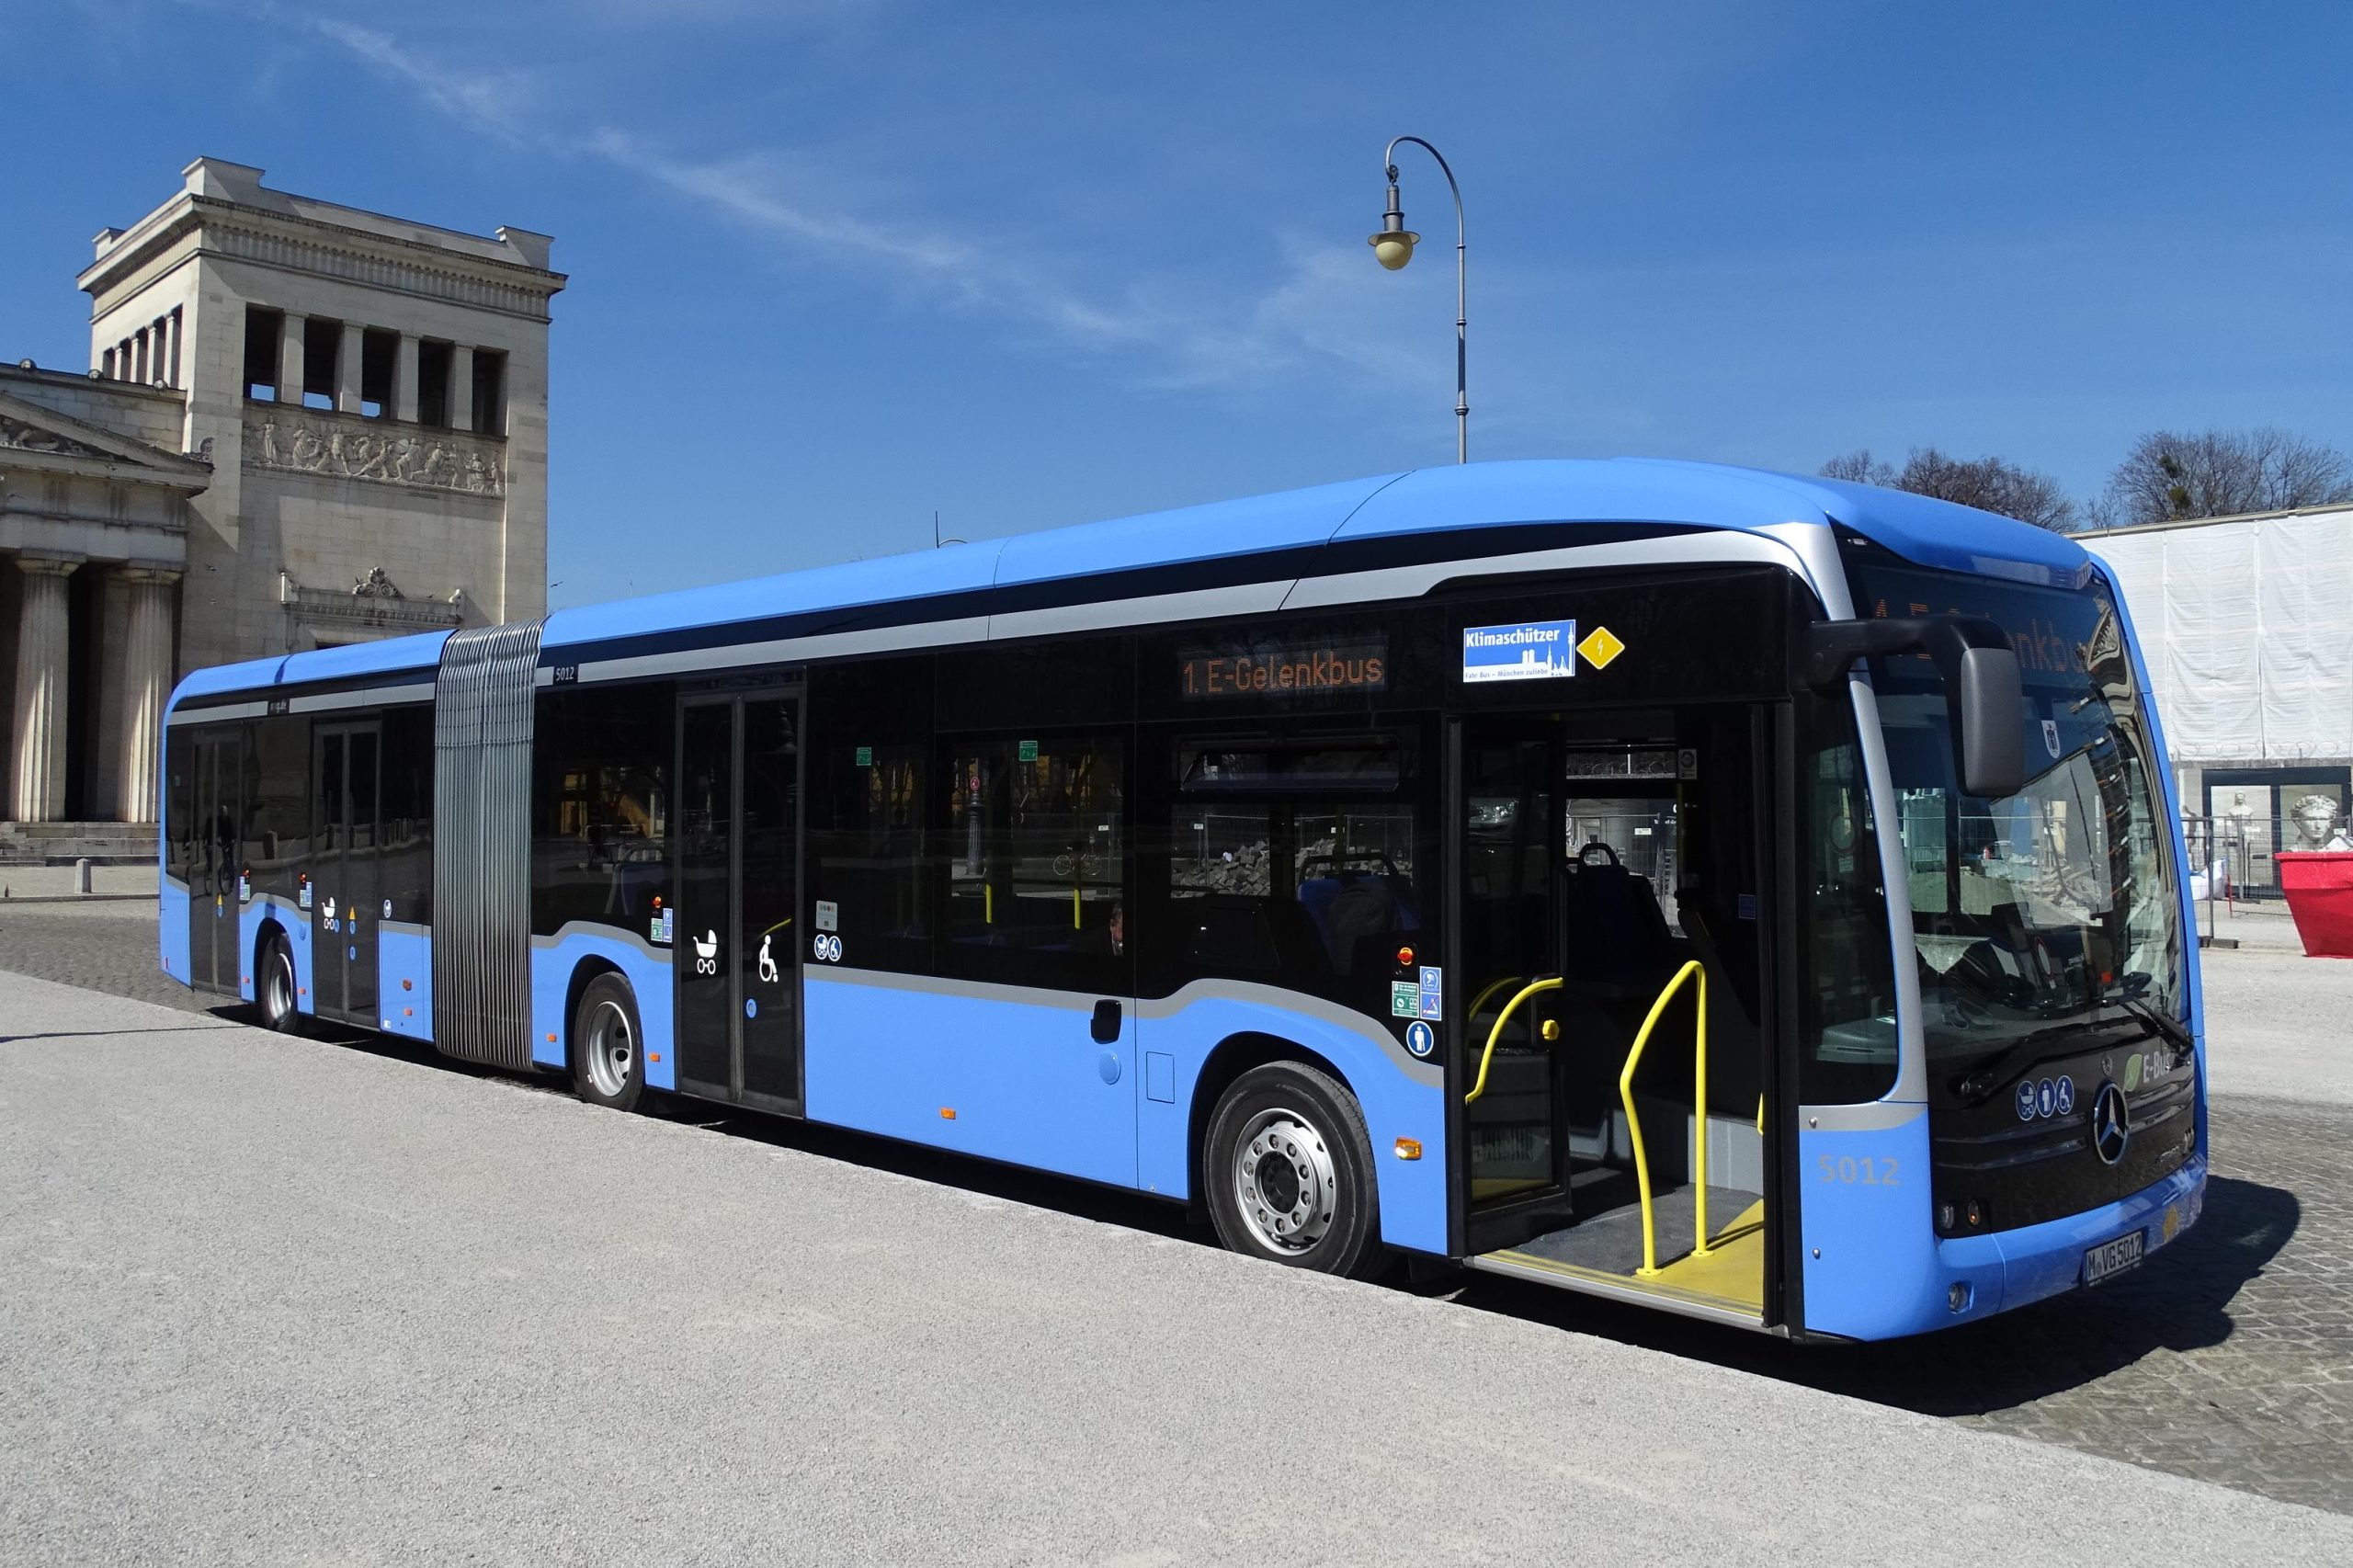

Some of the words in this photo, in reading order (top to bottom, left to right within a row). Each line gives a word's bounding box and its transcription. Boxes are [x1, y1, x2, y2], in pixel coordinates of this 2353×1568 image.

[1466, 628, 1561, 647] Klimaschützer
[556, 666, 574, 681] 5012
[1208, 651, 1383, 692] E-Gelenkbus
[1819, 1153, 1902, 1186] 5012
